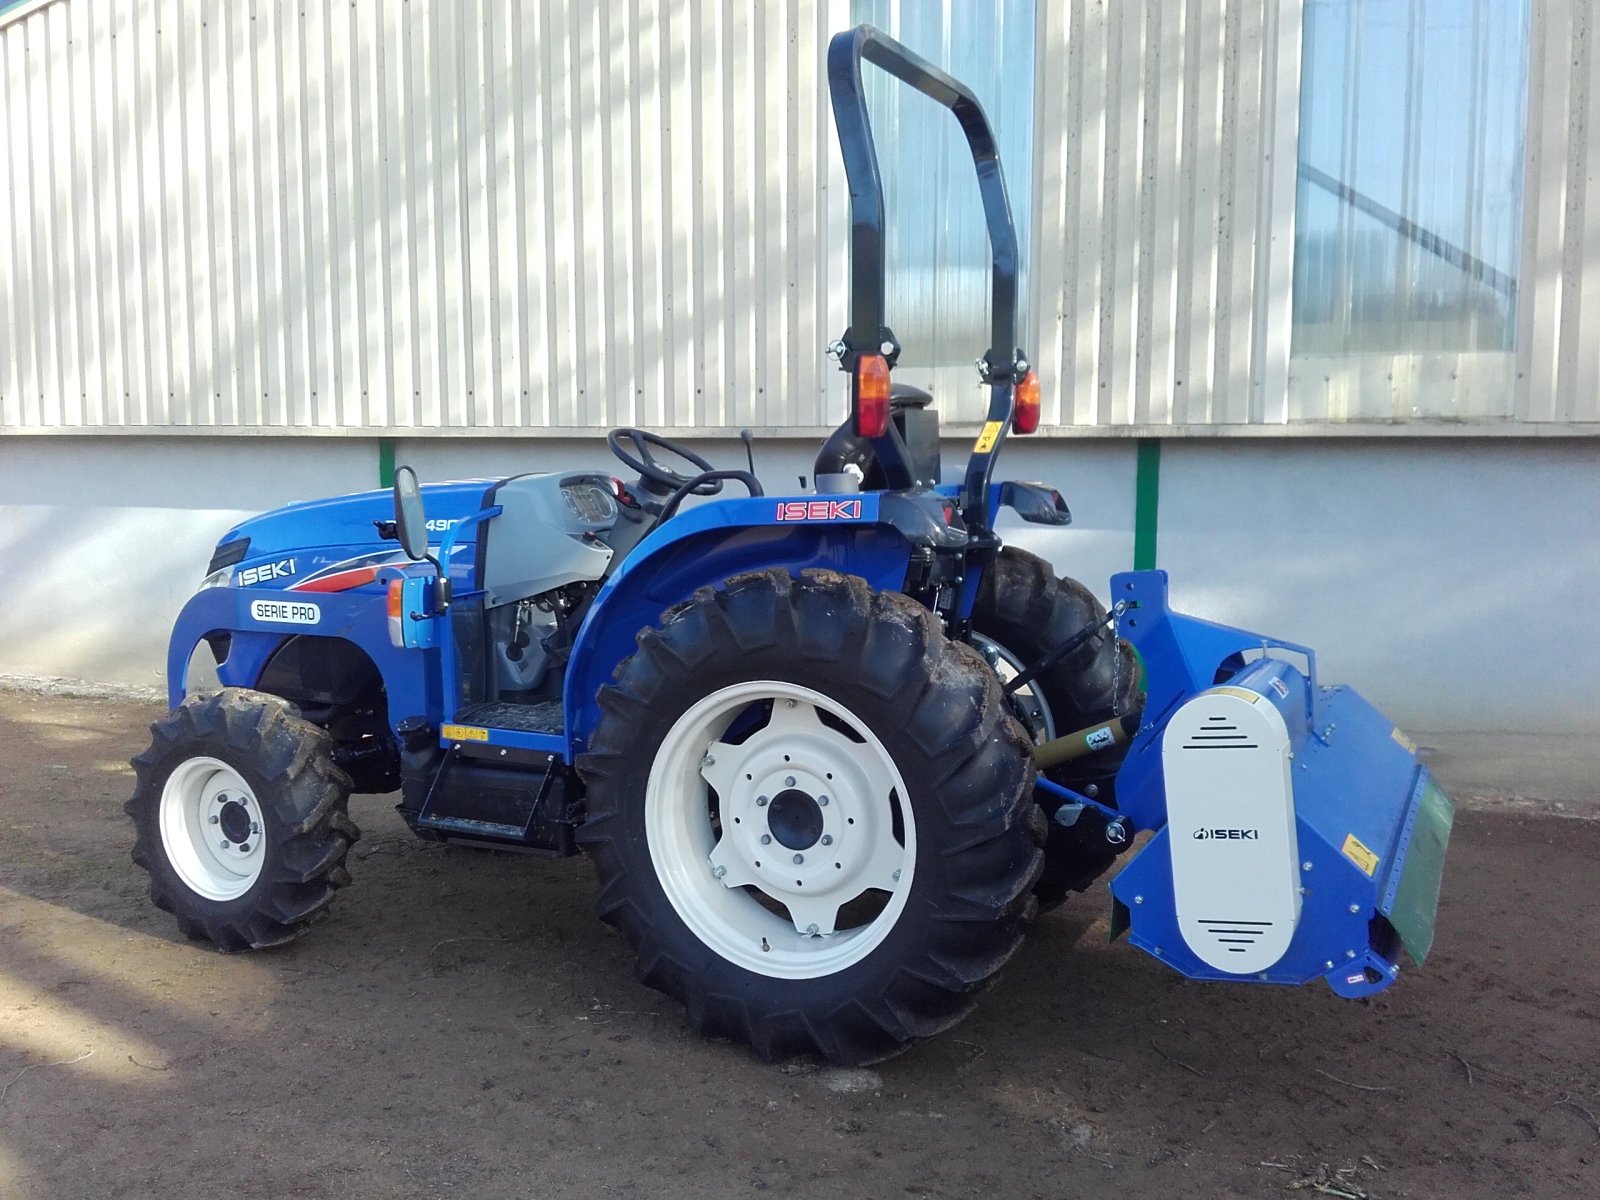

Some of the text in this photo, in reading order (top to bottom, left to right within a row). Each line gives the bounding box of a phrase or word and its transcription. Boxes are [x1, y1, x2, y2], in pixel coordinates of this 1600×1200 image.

[777, 500, 861, 521] ISEKI
[238, 558, 296, 587] ISEKI
[256, 604, 315, 621] SERIE PRO
[1210, 829, 1258, 840] ISEKI
